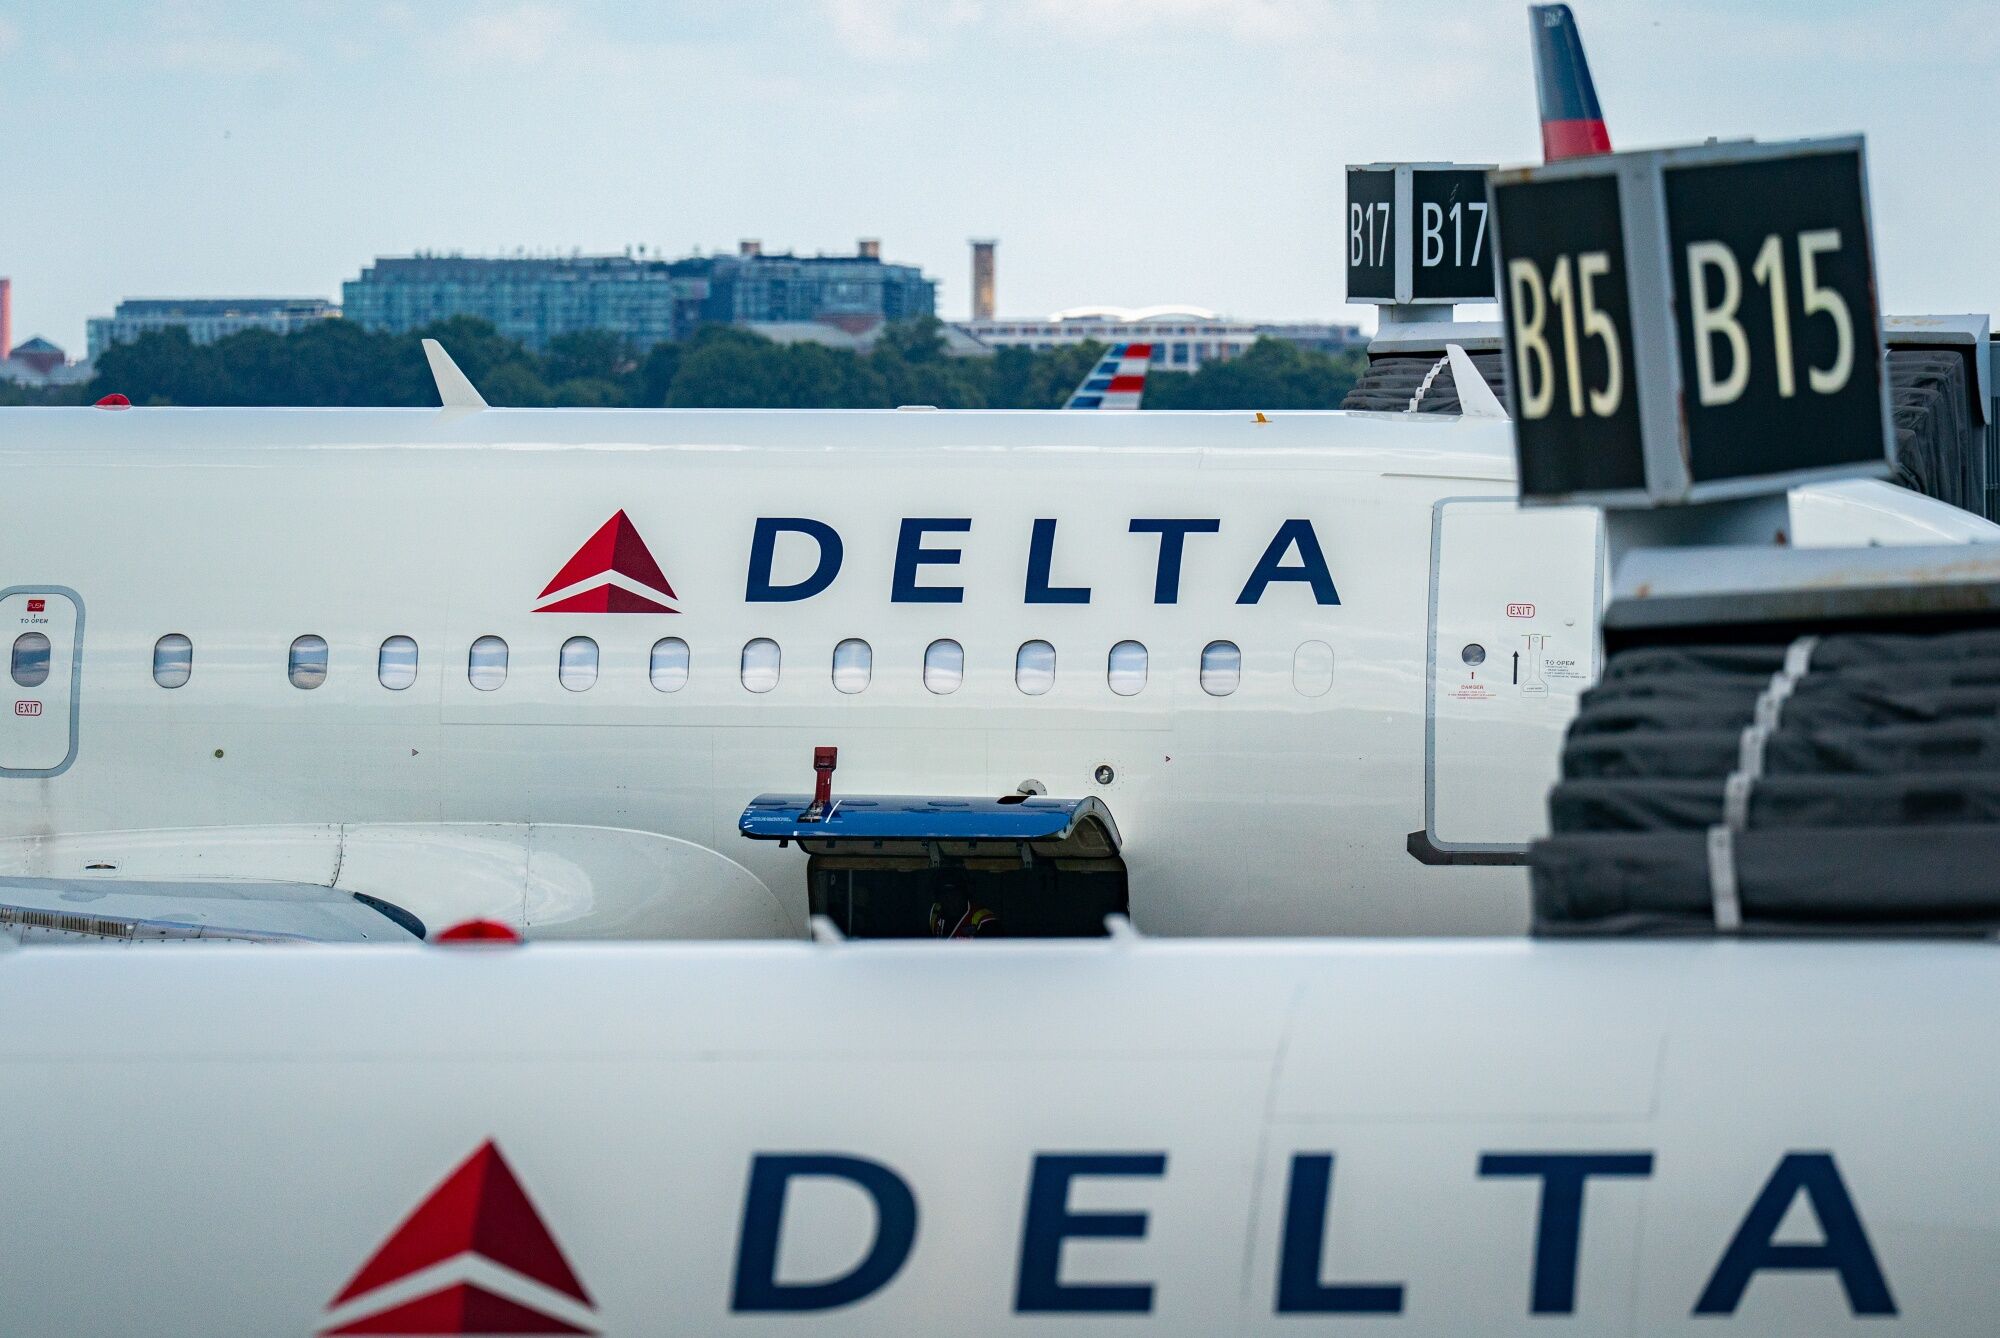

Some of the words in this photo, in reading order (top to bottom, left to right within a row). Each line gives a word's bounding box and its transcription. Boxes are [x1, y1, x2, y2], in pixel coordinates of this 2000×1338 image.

[1350, 202, 1390, 266] B17
[1422, 202, 1488, 266] B17
[1508, 250, 1625, 421] B15
[1688, 227, 1856, 407] B15
[745, 517, 1342, 606] DELTA
[1510, 606, 1532, 615] EXIT
[18, 703, 38, 713] EXIT
[728, 1150, 1900, 1318] DELTA
